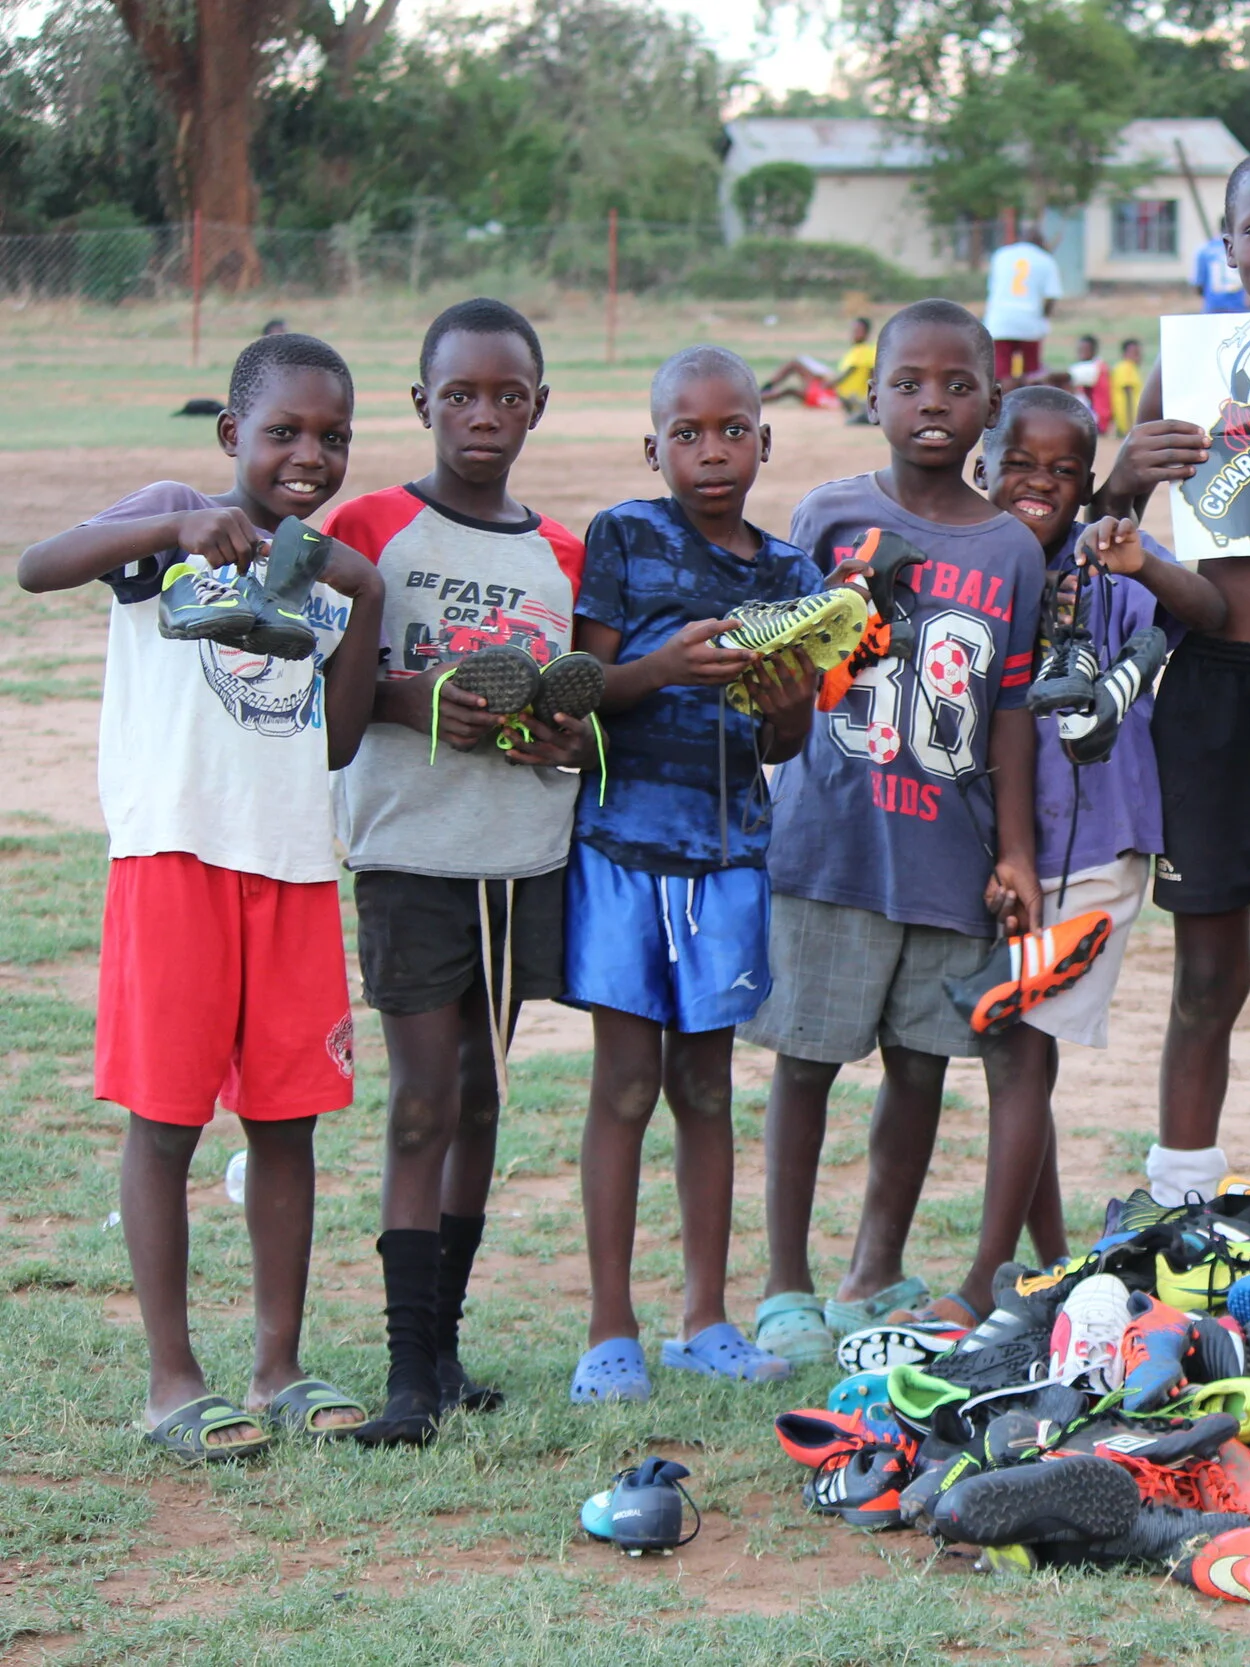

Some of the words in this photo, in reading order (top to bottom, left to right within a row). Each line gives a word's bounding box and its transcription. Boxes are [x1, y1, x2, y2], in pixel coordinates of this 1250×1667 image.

[406, 571, 440, 589] BE
[439, 578, 526, 610] FAST
[443, 606, 479, 623] OR
[870, 771, 942, 821] KIDS
